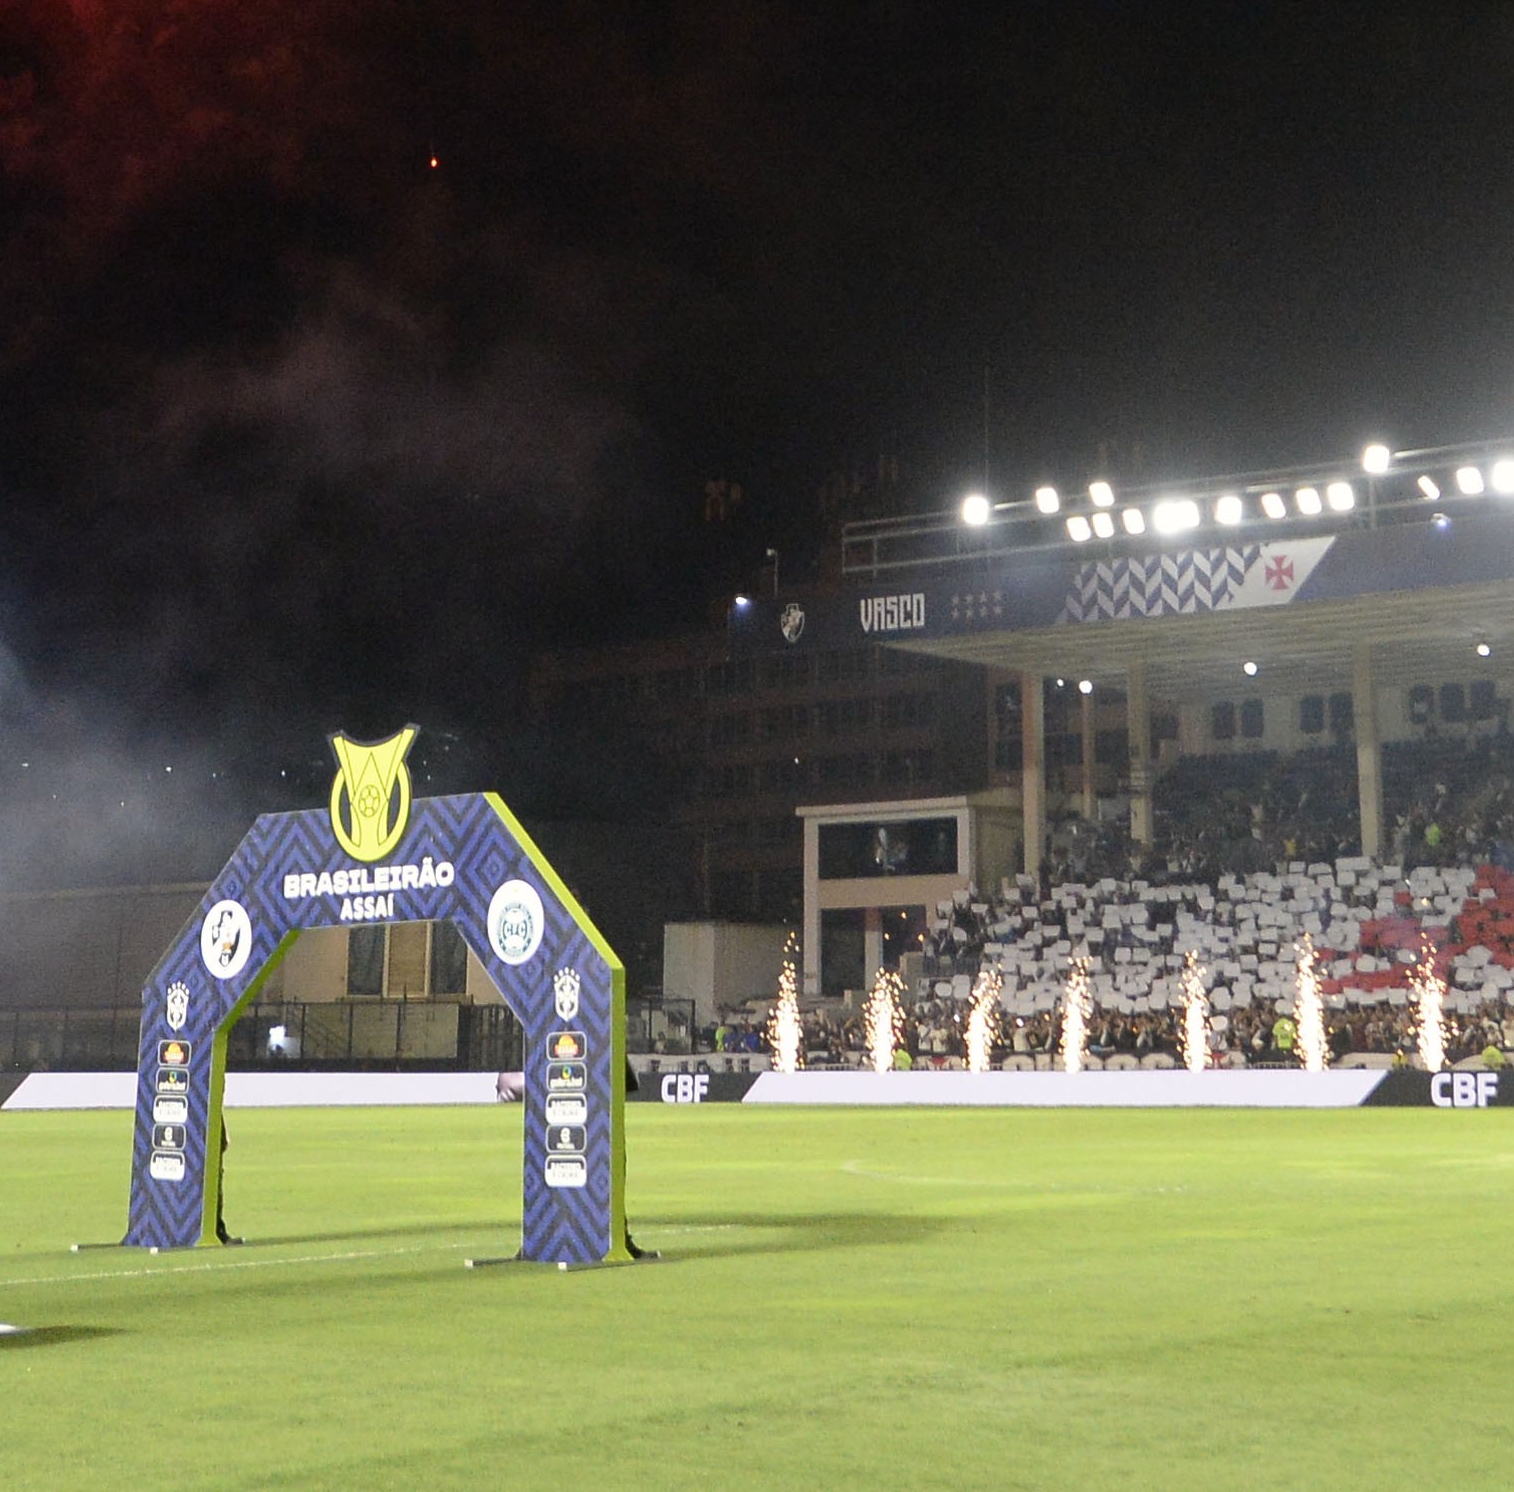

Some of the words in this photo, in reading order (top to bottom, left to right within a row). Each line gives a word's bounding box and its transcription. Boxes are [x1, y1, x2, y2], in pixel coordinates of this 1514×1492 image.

[860, 593, 925, 633] VASCO
[283, 856, 455, 899] BRASILEIRÃO
[340, 893, 394, 920] ASSAÍ
[661, 1074, 709, 1103] CBF
[1430, 1072, 1499, 1107] CBF
